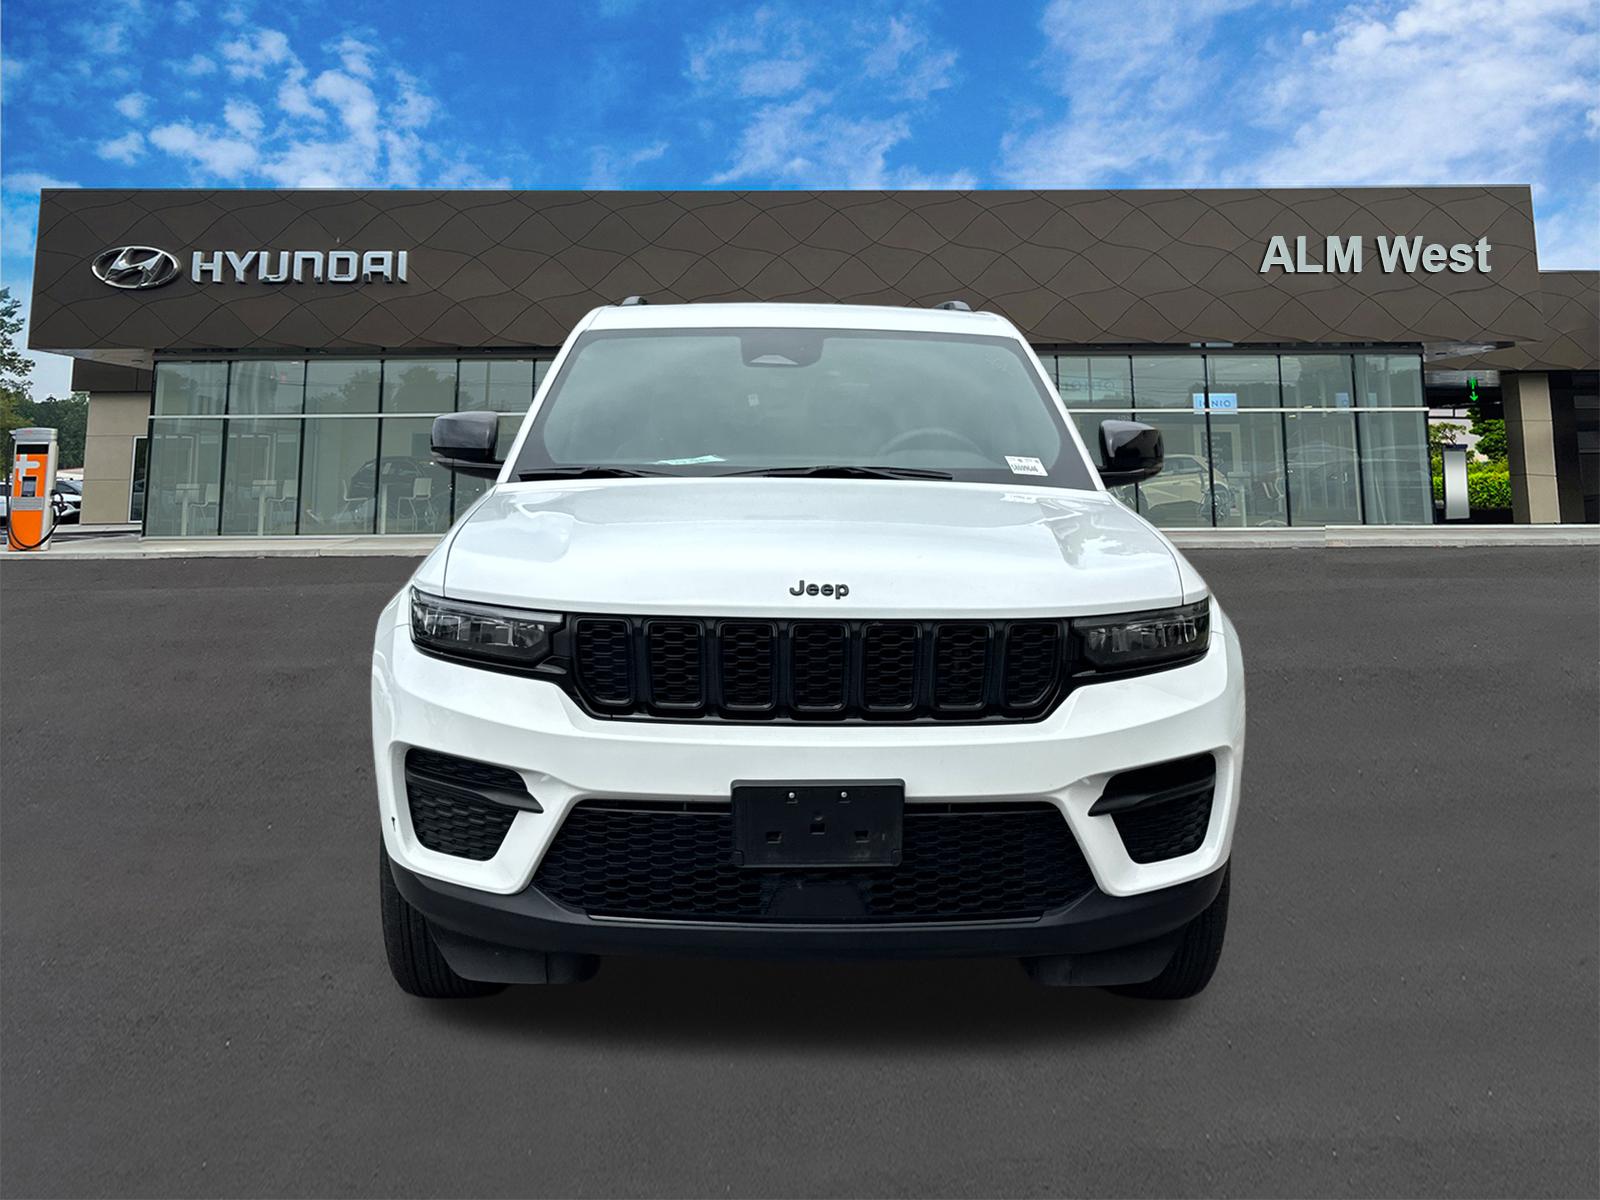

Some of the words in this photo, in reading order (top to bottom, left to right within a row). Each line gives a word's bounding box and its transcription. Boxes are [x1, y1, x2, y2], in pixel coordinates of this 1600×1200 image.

[191, 250, 408, 284] HYUNDAI
[1259, 235, 1363, 273] ALM
[1376, 235, 1492, 273] West
[789, 579, 850, 600] Jeep
